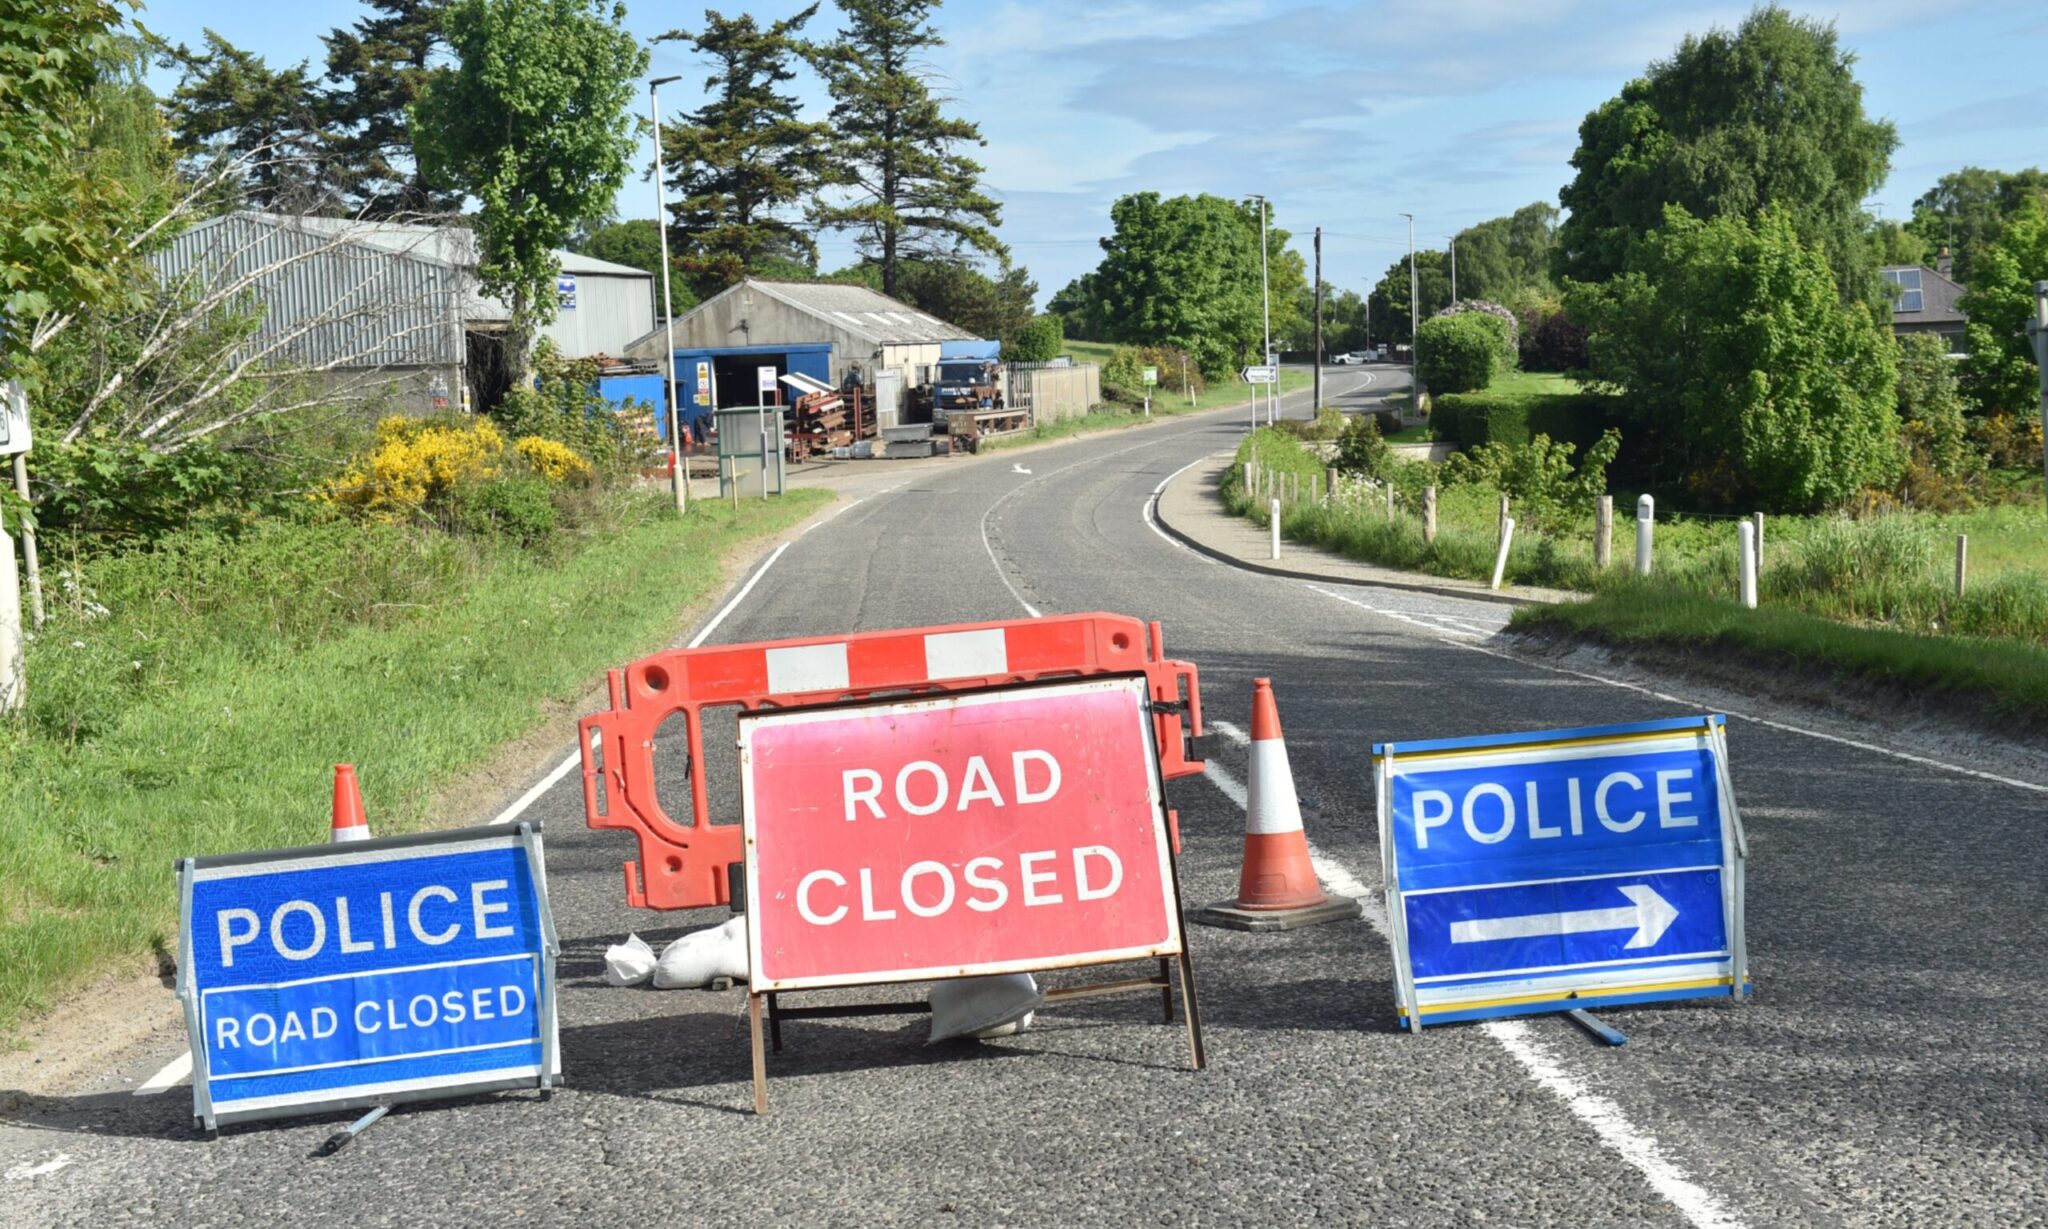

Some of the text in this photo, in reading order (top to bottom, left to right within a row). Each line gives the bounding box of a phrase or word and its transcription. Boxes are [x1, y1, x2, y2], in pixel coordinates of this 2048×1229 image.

[842, 749, 1062, 821] ROAD
[1412, 768, 1699, 850] POLICE
[217, 879, 515, 968] POLICE
[796, 845, 1123, 926] CLOSED
[217, 985, 526, 1049] ROAD CLOSED
